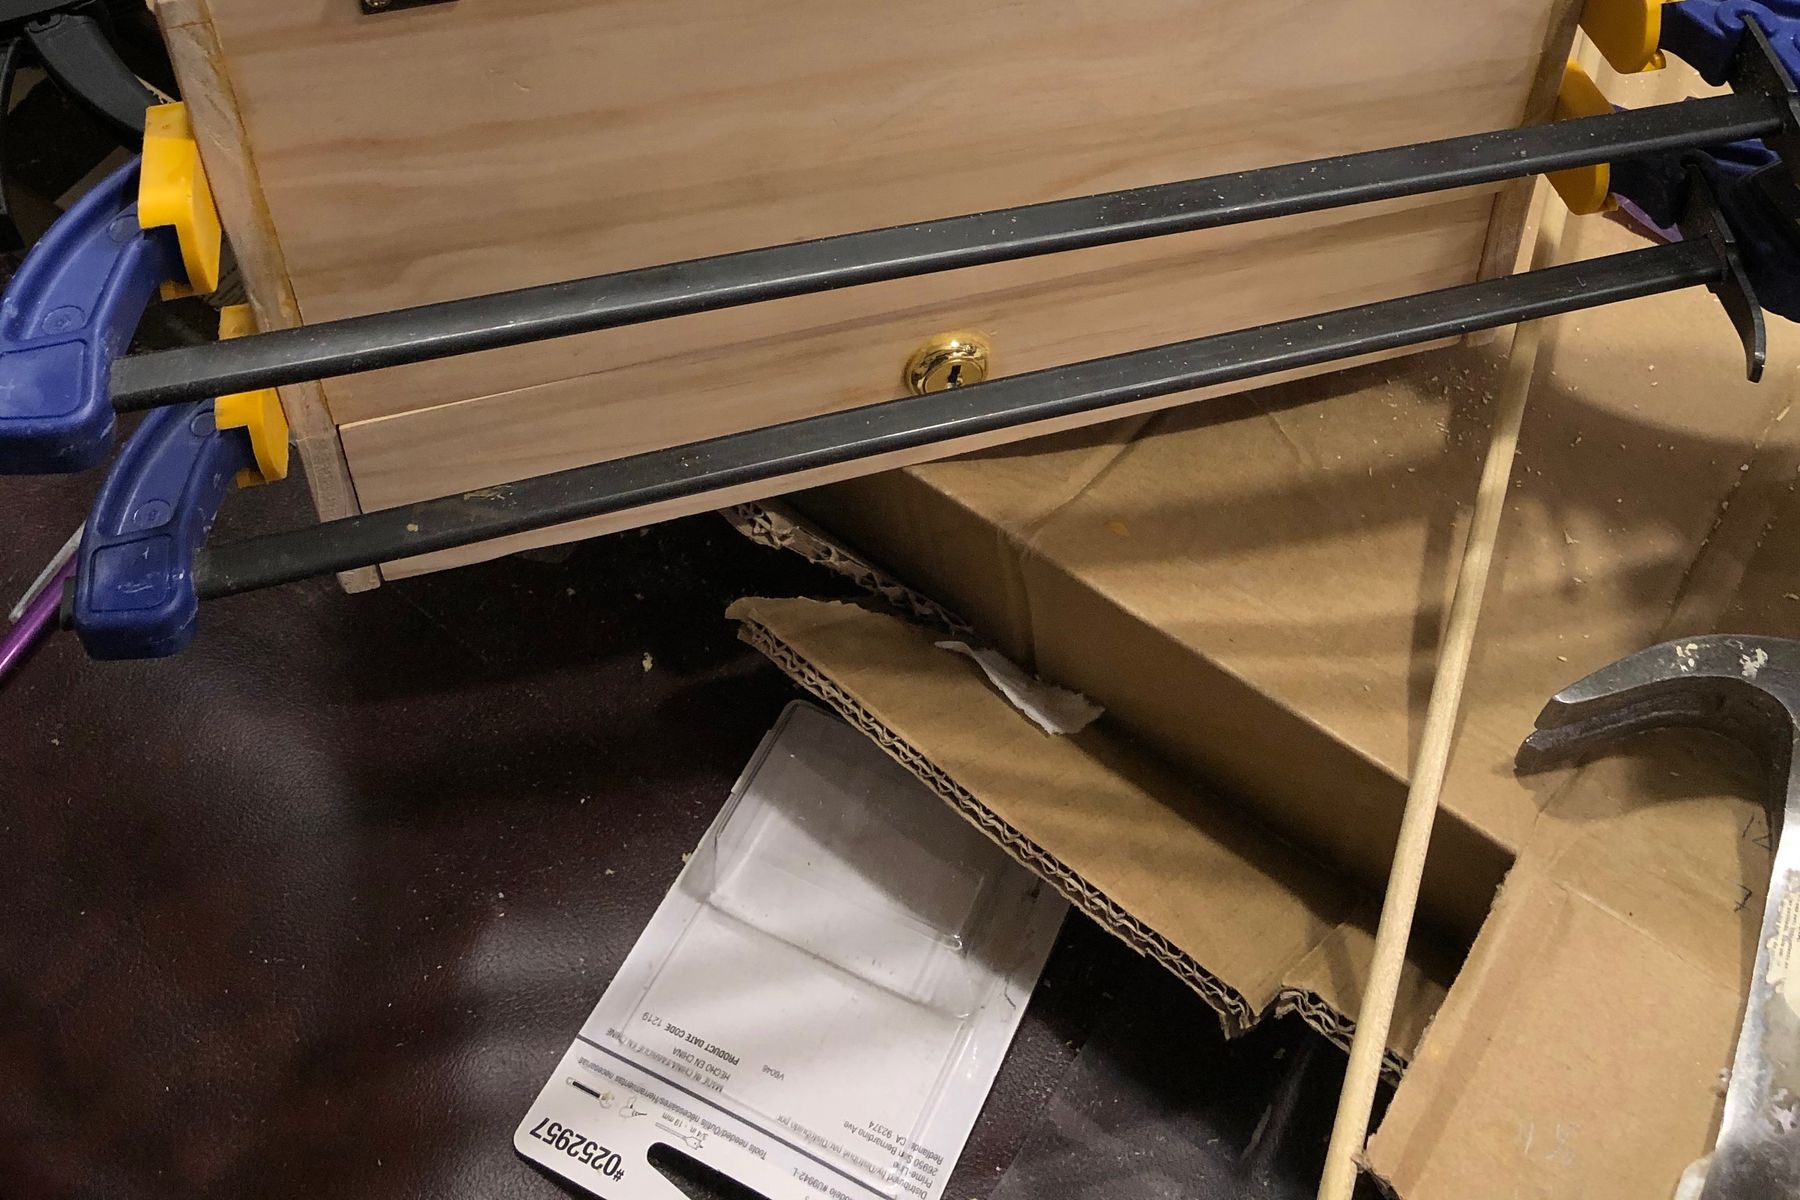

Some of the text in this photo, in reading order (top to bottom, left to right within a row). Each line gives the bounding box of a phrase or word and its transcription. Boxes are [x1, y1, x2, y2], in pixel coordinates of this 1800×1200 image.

[641, 1011, 739, 1065] PRODUCT DATE CODE 1219
[672, 1046, 730, 1081] HECHO EN CHINA
[662, 1112, 674, 1122] mm
[699, 1118, 748, 1149] needed/Outils
[868, 1120, 893, 1137] 92374
[894, 1134, 906, 1145] CA
[529, 1117, 624, 1182] #0252957
[747, 1143, 767, 1159] Tools
[857, 1128, 897, 1154] Bernardino
[913, 1157, 938, 1175] 26950
